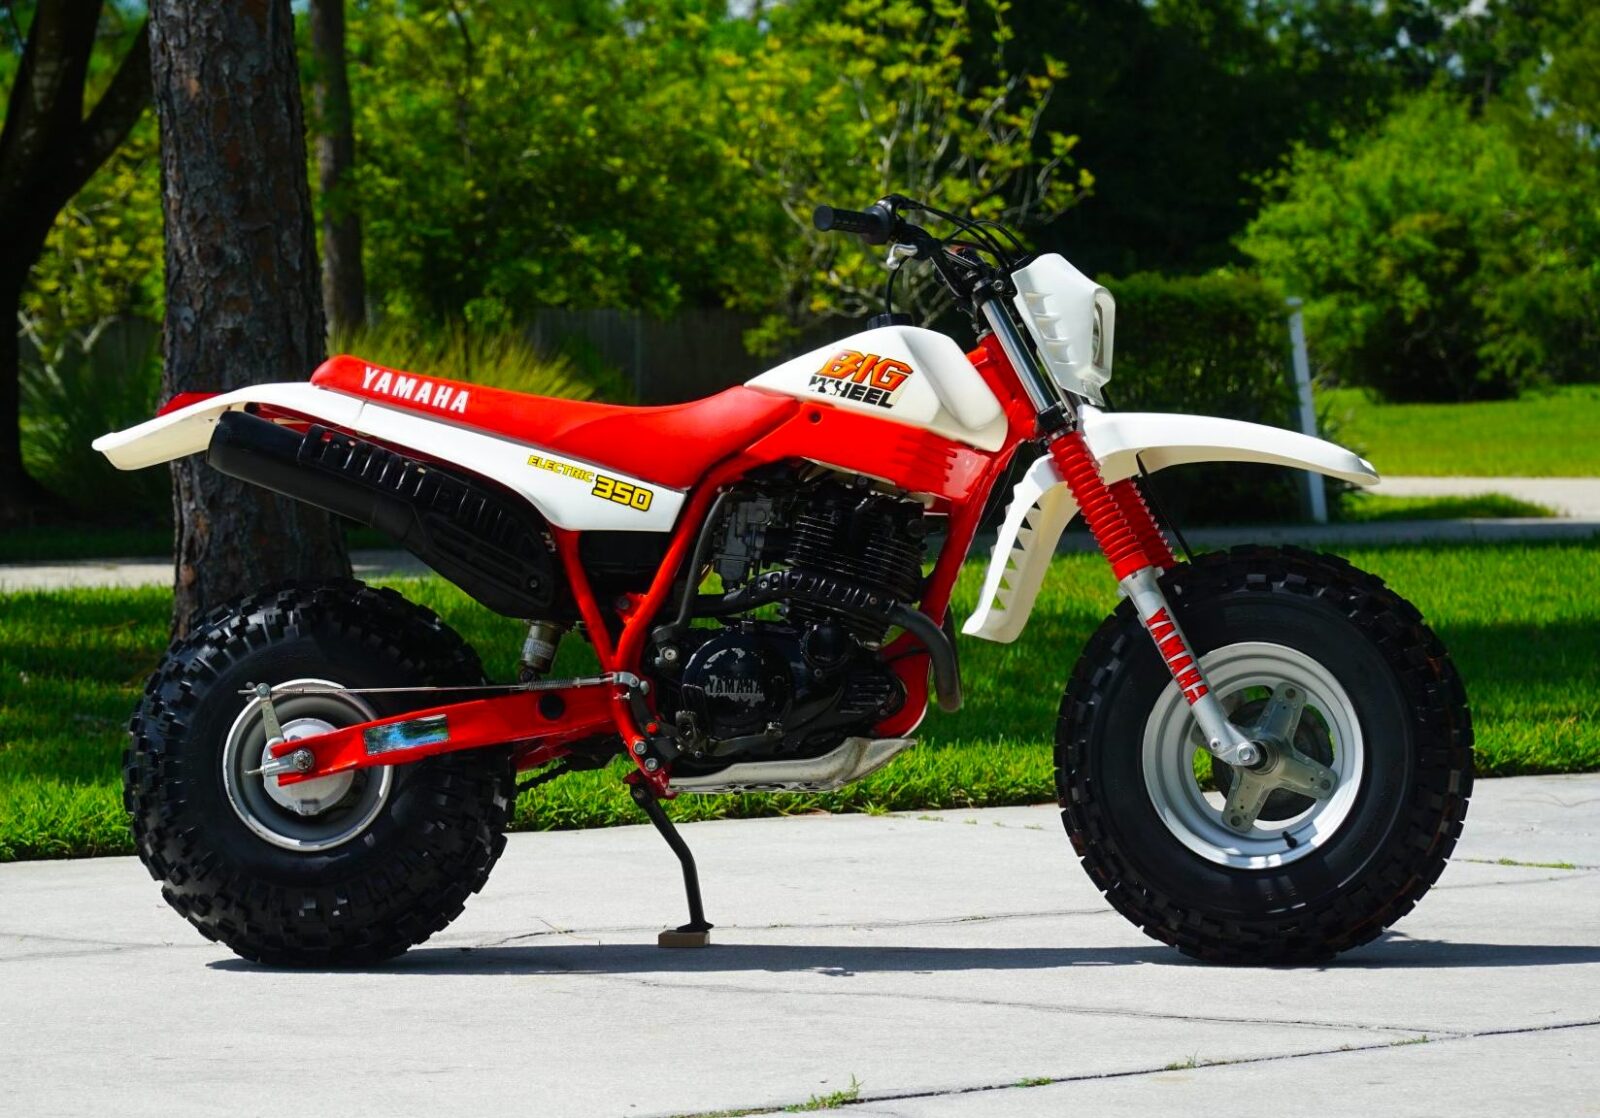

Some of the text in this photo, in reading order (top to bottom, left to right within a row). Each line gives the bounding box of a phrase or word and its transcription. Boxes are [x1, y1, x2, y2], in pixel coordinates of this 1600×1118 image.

[362, 367, 469, 413] YAMAHA
[815, 349, 914, 392] BIG
[527, 454, 654, 512] ELECTRIC 350
[1145, 606, 1209, 705] YAMAHA
[707, 677, 762, 693] YAMAHA
